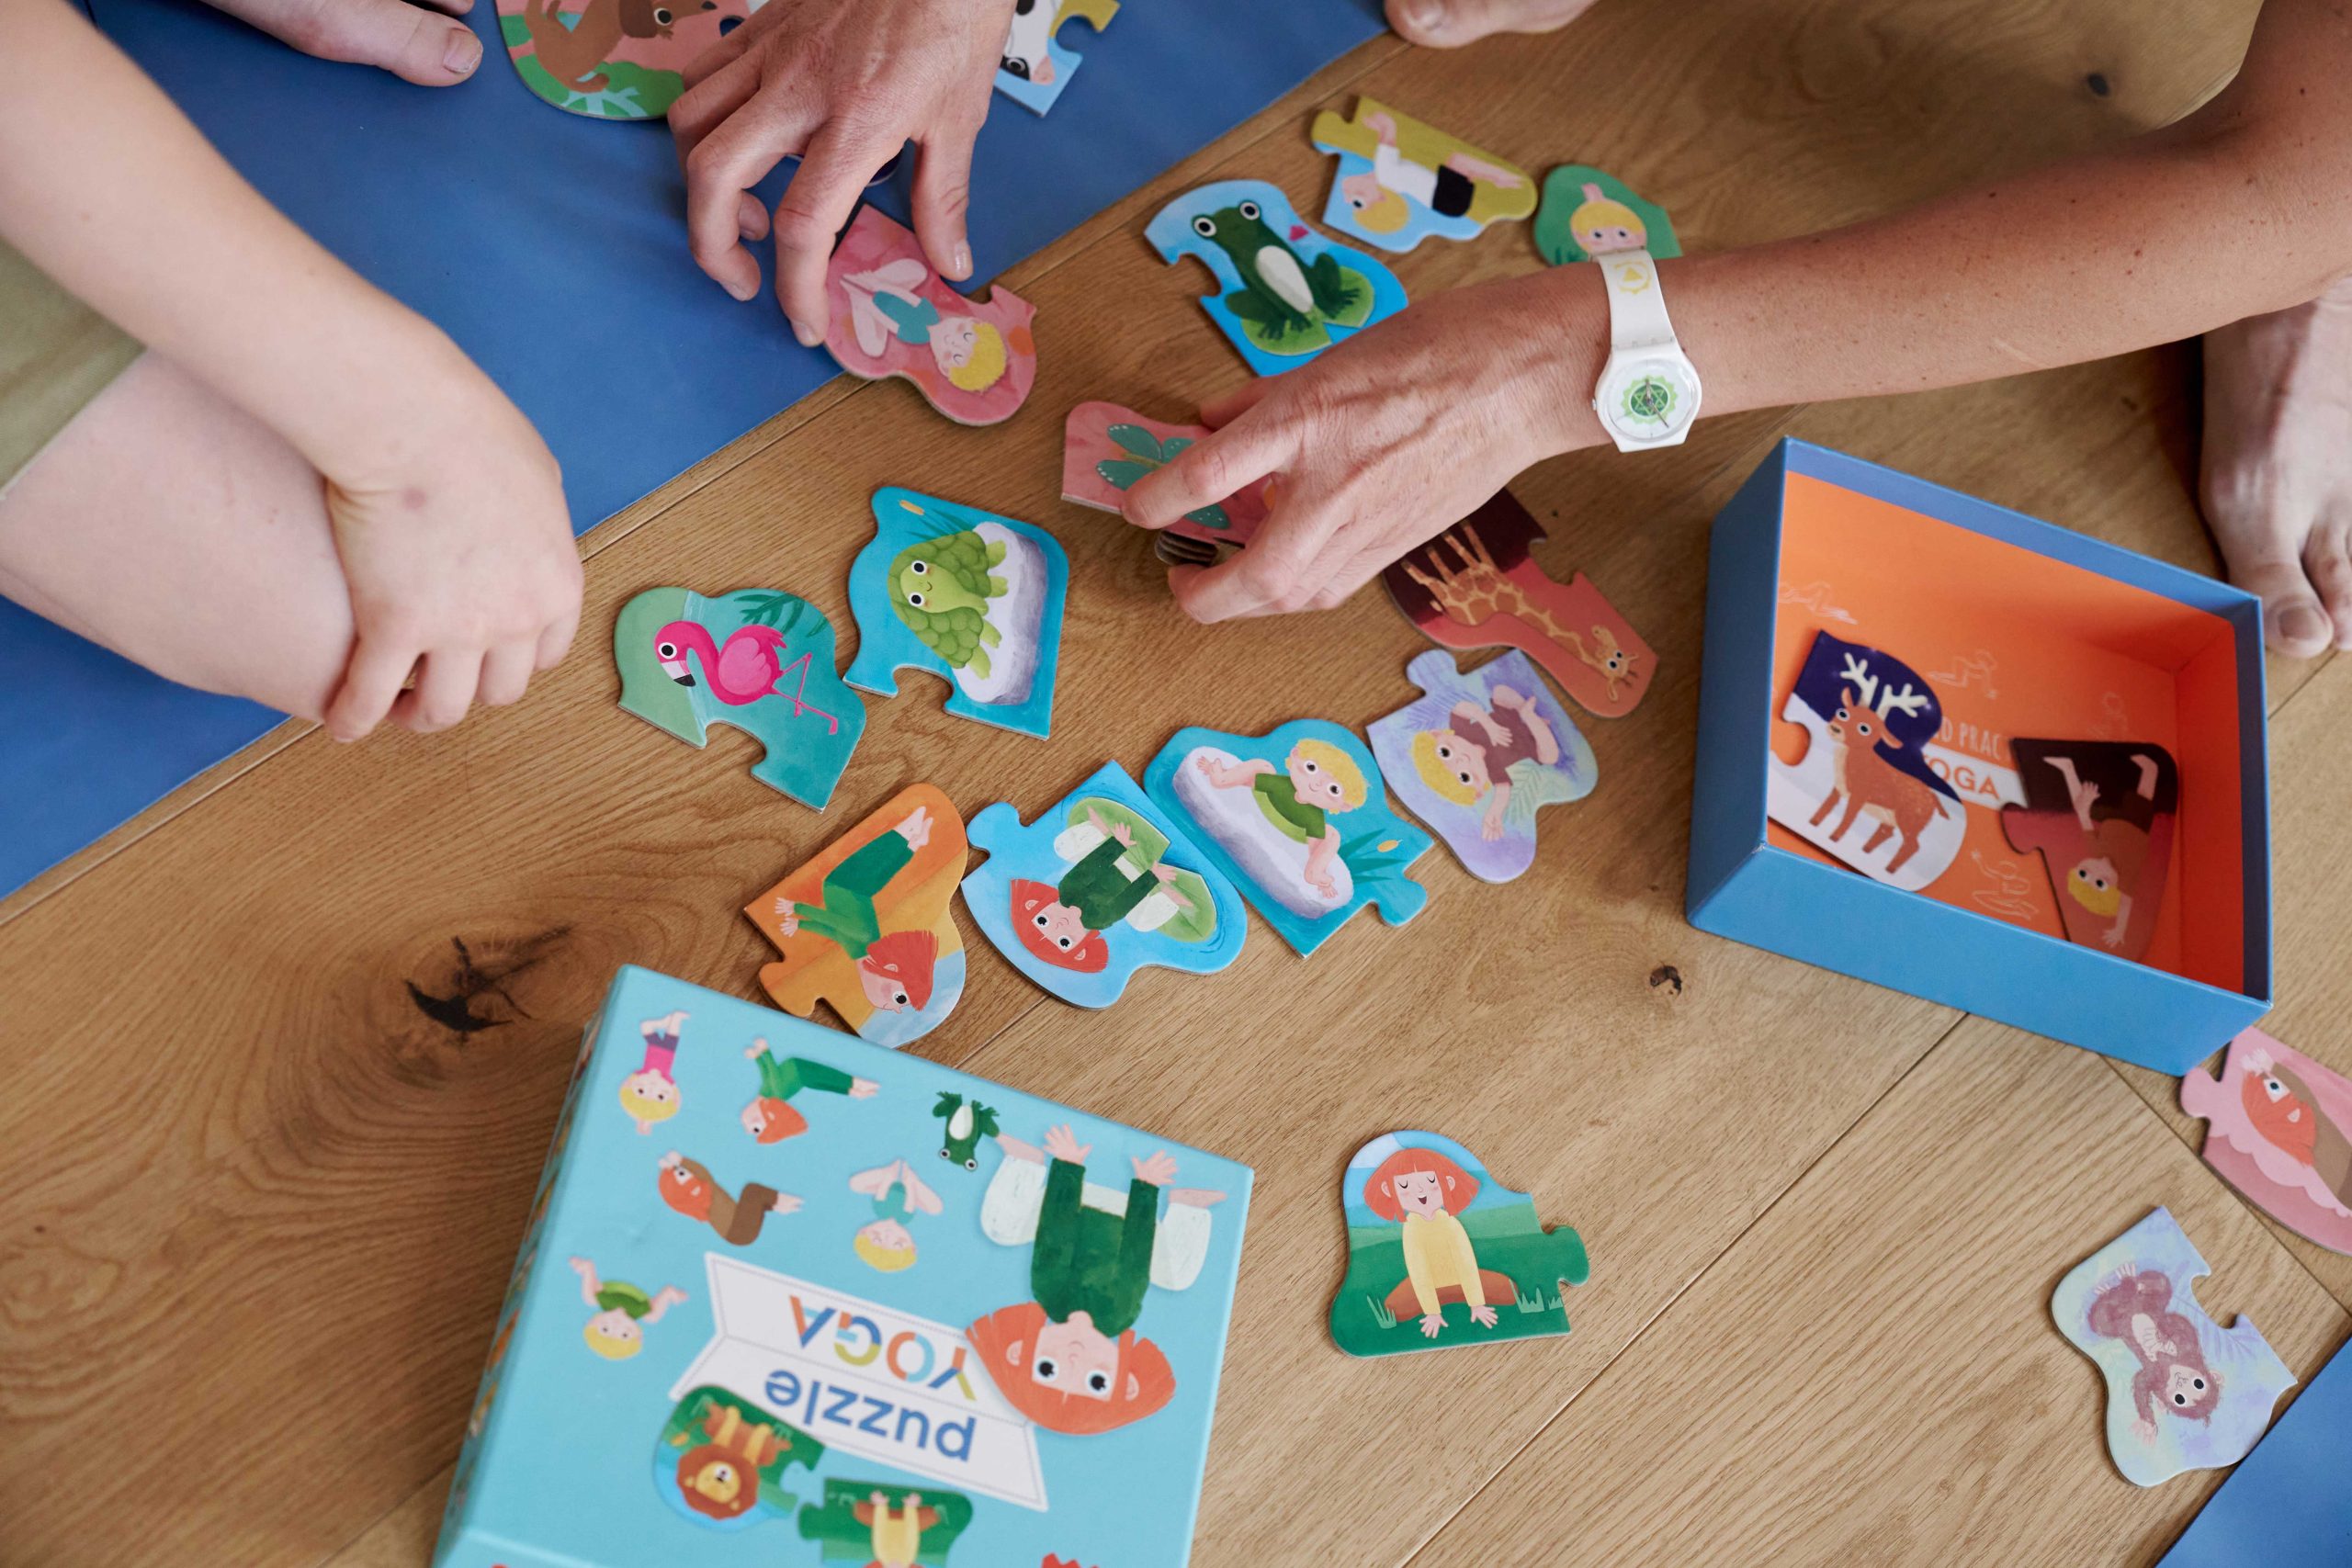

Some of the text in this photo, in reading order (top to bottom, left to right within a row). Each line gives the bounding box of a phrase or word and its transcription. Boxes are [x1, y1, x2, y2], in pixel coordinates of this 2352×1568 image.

[1925, 756, 2000, 800] OGA
[789, 1295, 977, 1401] YOGA
[765, 1370, 976, 1461] puzzle
